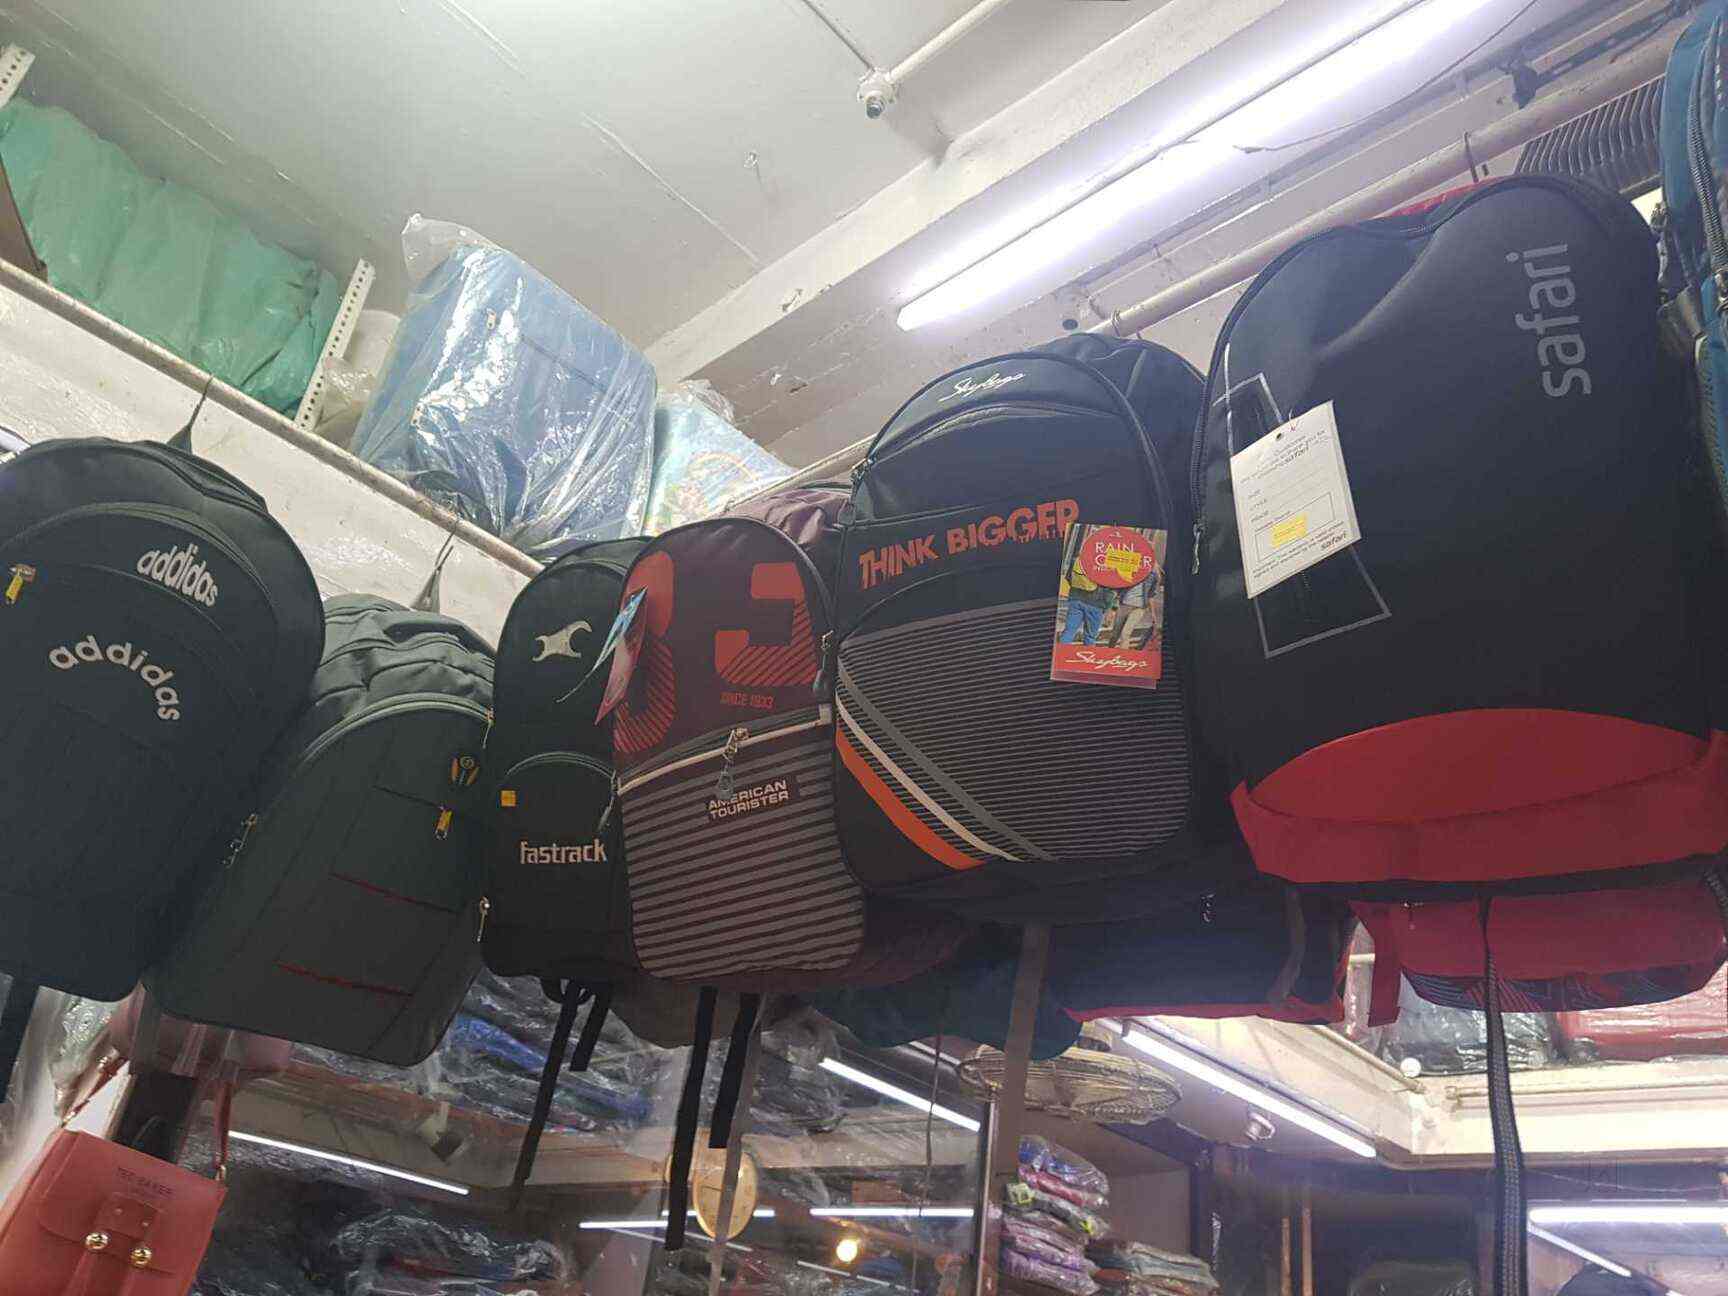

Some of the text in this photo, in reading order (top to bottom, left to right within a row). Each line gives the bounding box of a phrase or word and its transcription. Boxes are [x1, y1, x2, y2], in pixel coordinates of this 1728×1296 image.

[1505, 243, 1592, 397] safari
[859, 499, 1079, 591] THINK BIGGER
[1095, 541, 1134, 554] RAIN
[136, 543, 218, 607] addidas
[1065, 650, 1148, 672] Skybags
[48, 634, 180, 721] addidas
[708, 779, 787, 810] AMERICAN
[710, 790, 790, 820] TOURISTER
[520, 838, 608, 865] fastrack
